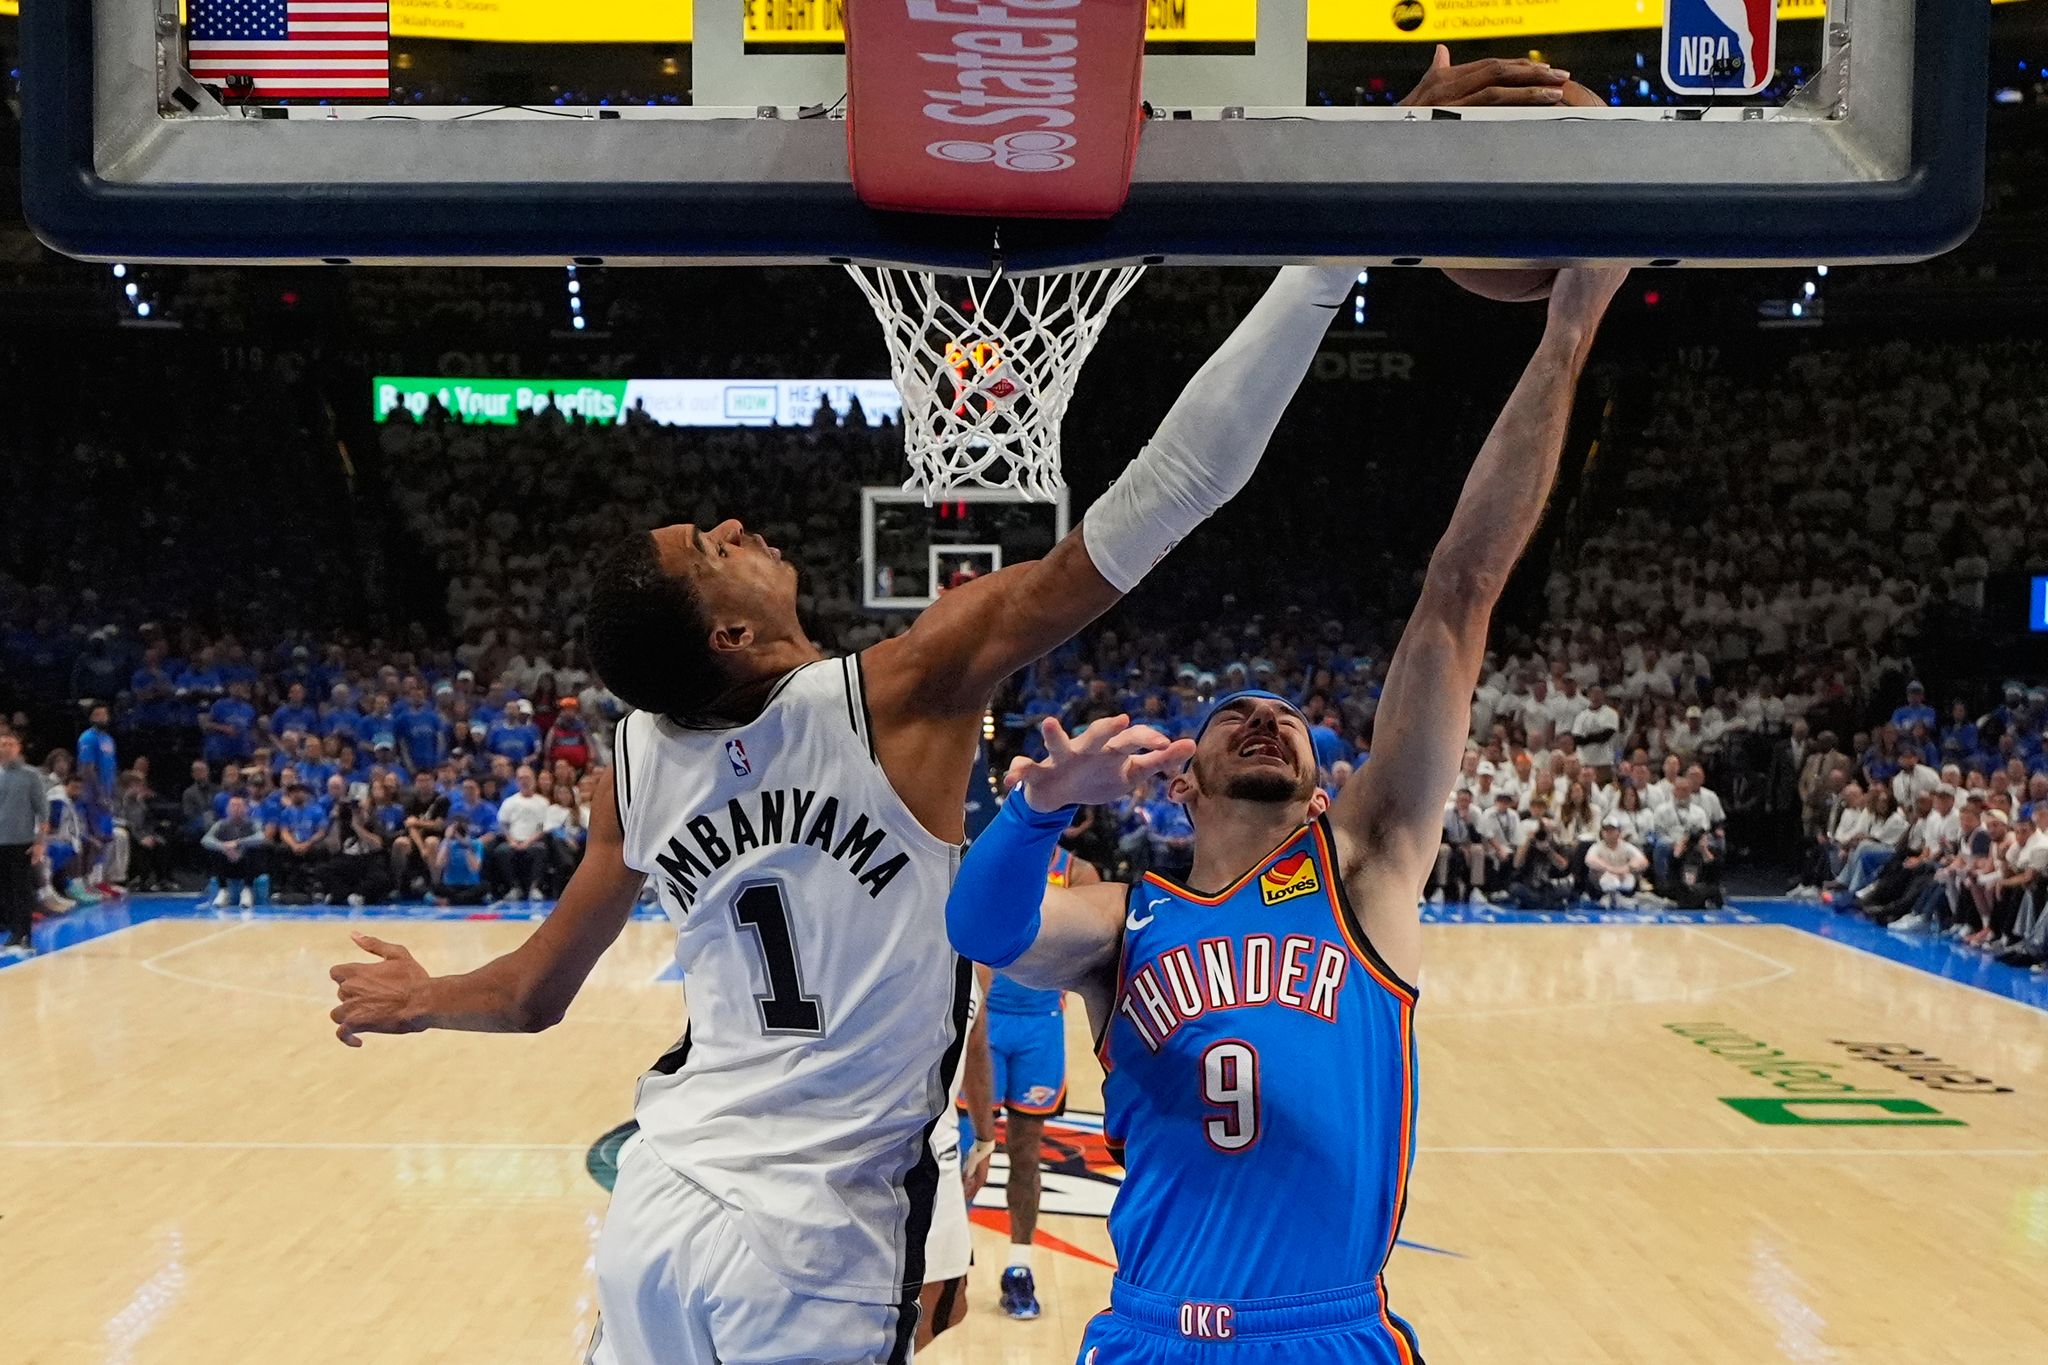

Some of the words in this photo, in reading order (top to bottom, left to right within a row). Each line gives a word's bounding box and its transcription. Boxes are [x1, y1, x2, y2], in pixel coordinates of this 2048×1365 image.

[1679, 36, 1731, 76] NBA
[454, 386, 512, 418] Your
[1265, 876, 1317, 903] Love's
[729, 877, 827, 1040] 1
[1119, 932, 1350, 1056] THUNDER
[1199, 1037, 1261, 1155] 9
[1177, 1301, 1236, 1342] OKC
